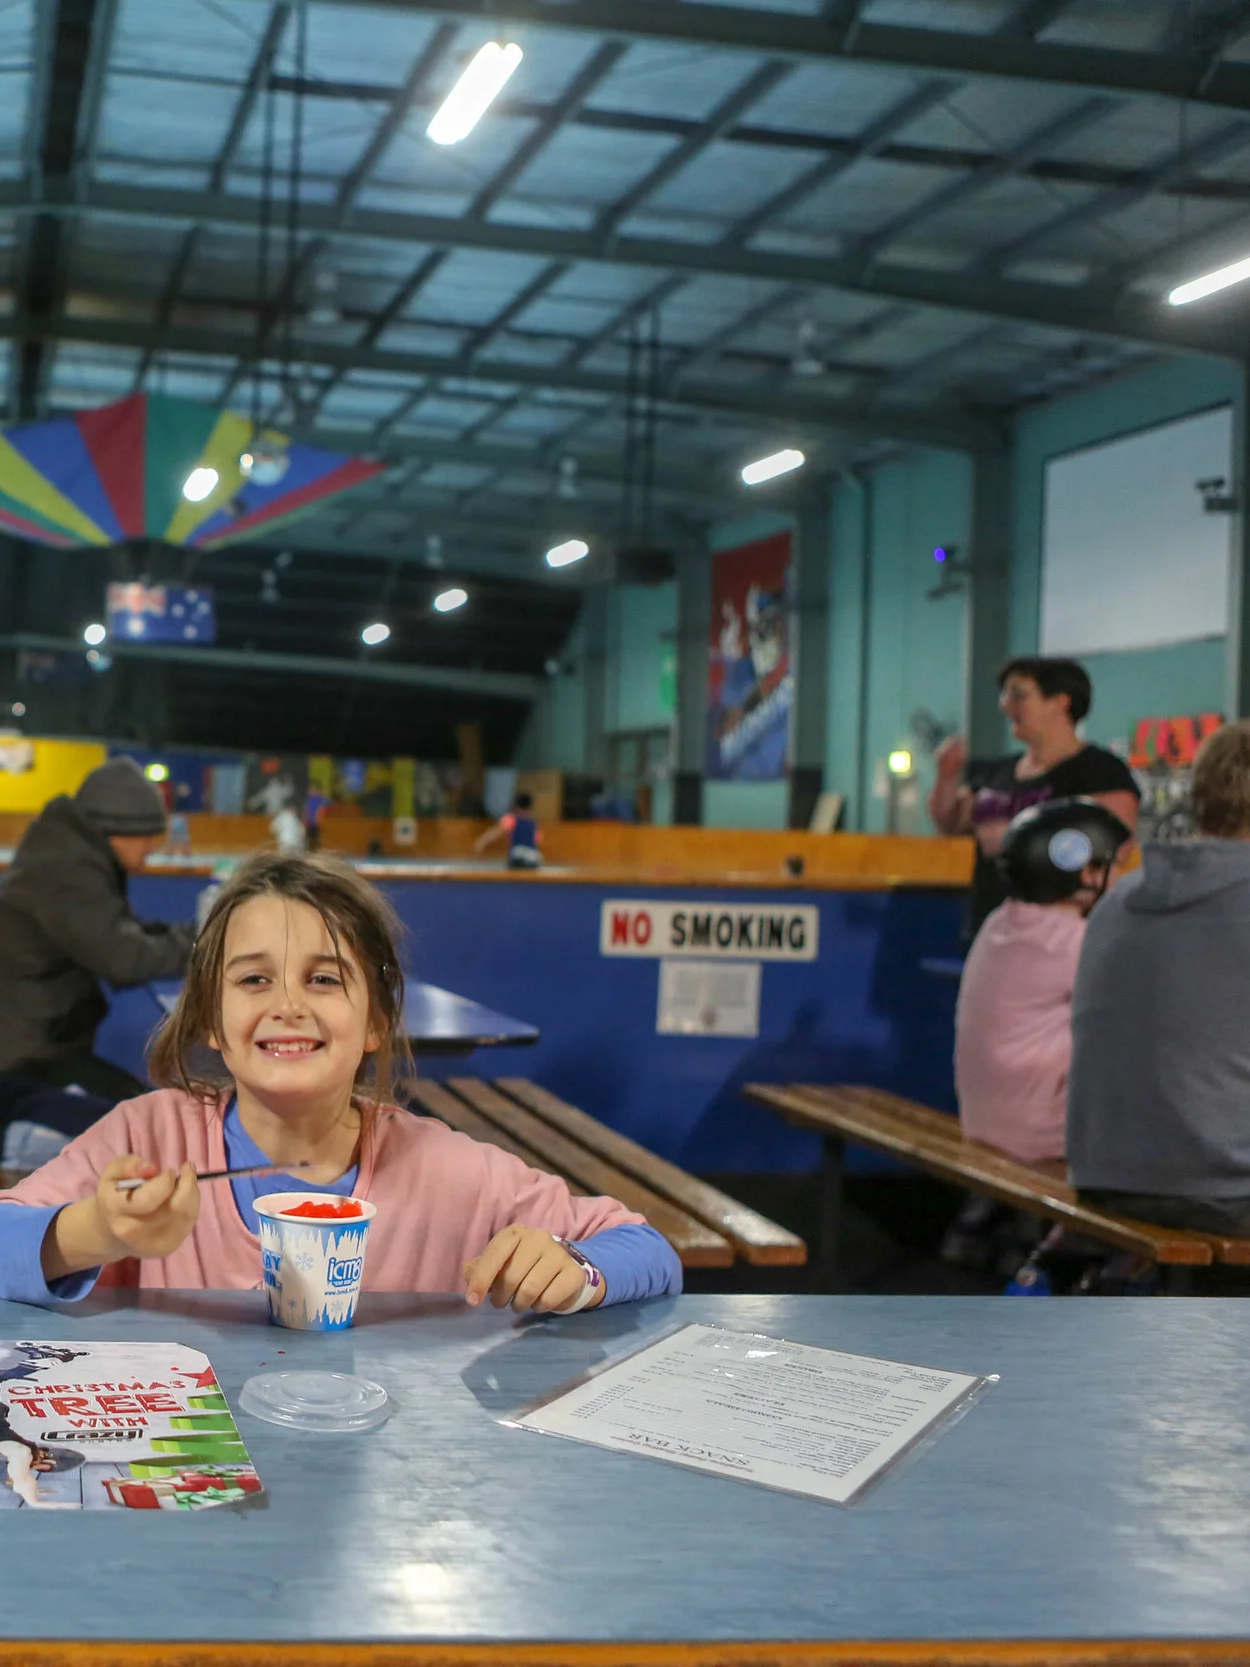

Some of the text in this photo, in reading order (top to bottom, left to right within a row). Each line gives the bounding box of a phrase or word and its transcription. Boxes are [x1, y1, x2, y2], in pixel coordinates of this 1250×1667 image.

[610, 911, 805, 949] NO SMOKING
[7, 1380, 187, 1395] CHRISTMAS
[9, 1393, 185, 1418] TREE
[67, 1417, 149, 1428] WITH
[674, 1444, 751, 1466] SNACK
